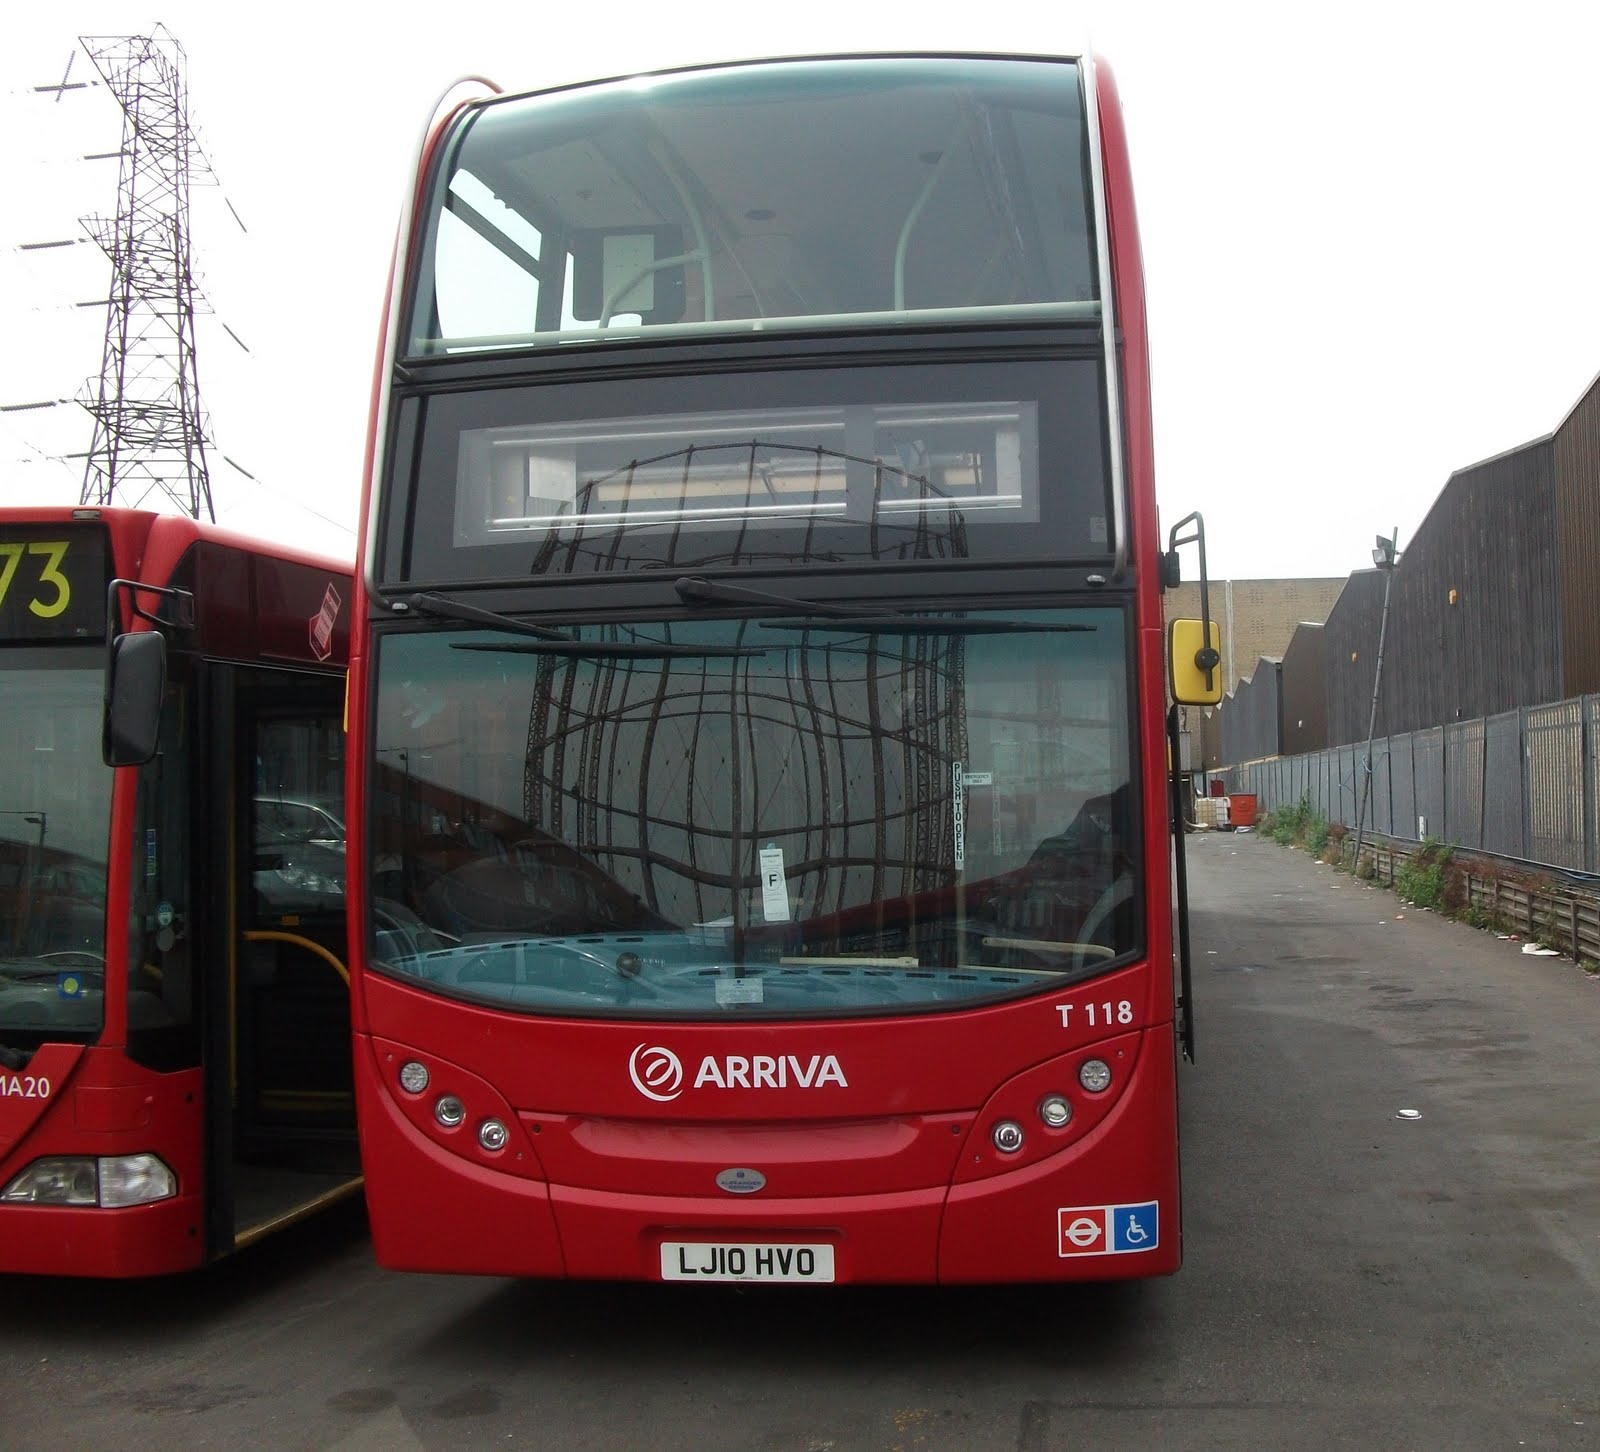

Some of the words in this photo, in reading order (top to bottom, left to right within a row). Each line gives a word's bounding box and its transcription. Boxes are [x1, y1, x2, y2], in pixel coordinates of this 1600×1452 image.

[954, 763, 962, 800] PUSH
[955, 802, 963, 821] TO
[955, 823, 963, 860] OPEN
[769, 874, 777, 887] F
[1055, 1004, 1074, 1028] T
[1085, 1000, 1133, 1026] 118
[693, 1055, 849, 1089] ARRIVA
[679, 1247, 746, 1275] LJ10
[755, 1248, 815, 1276] HVO
